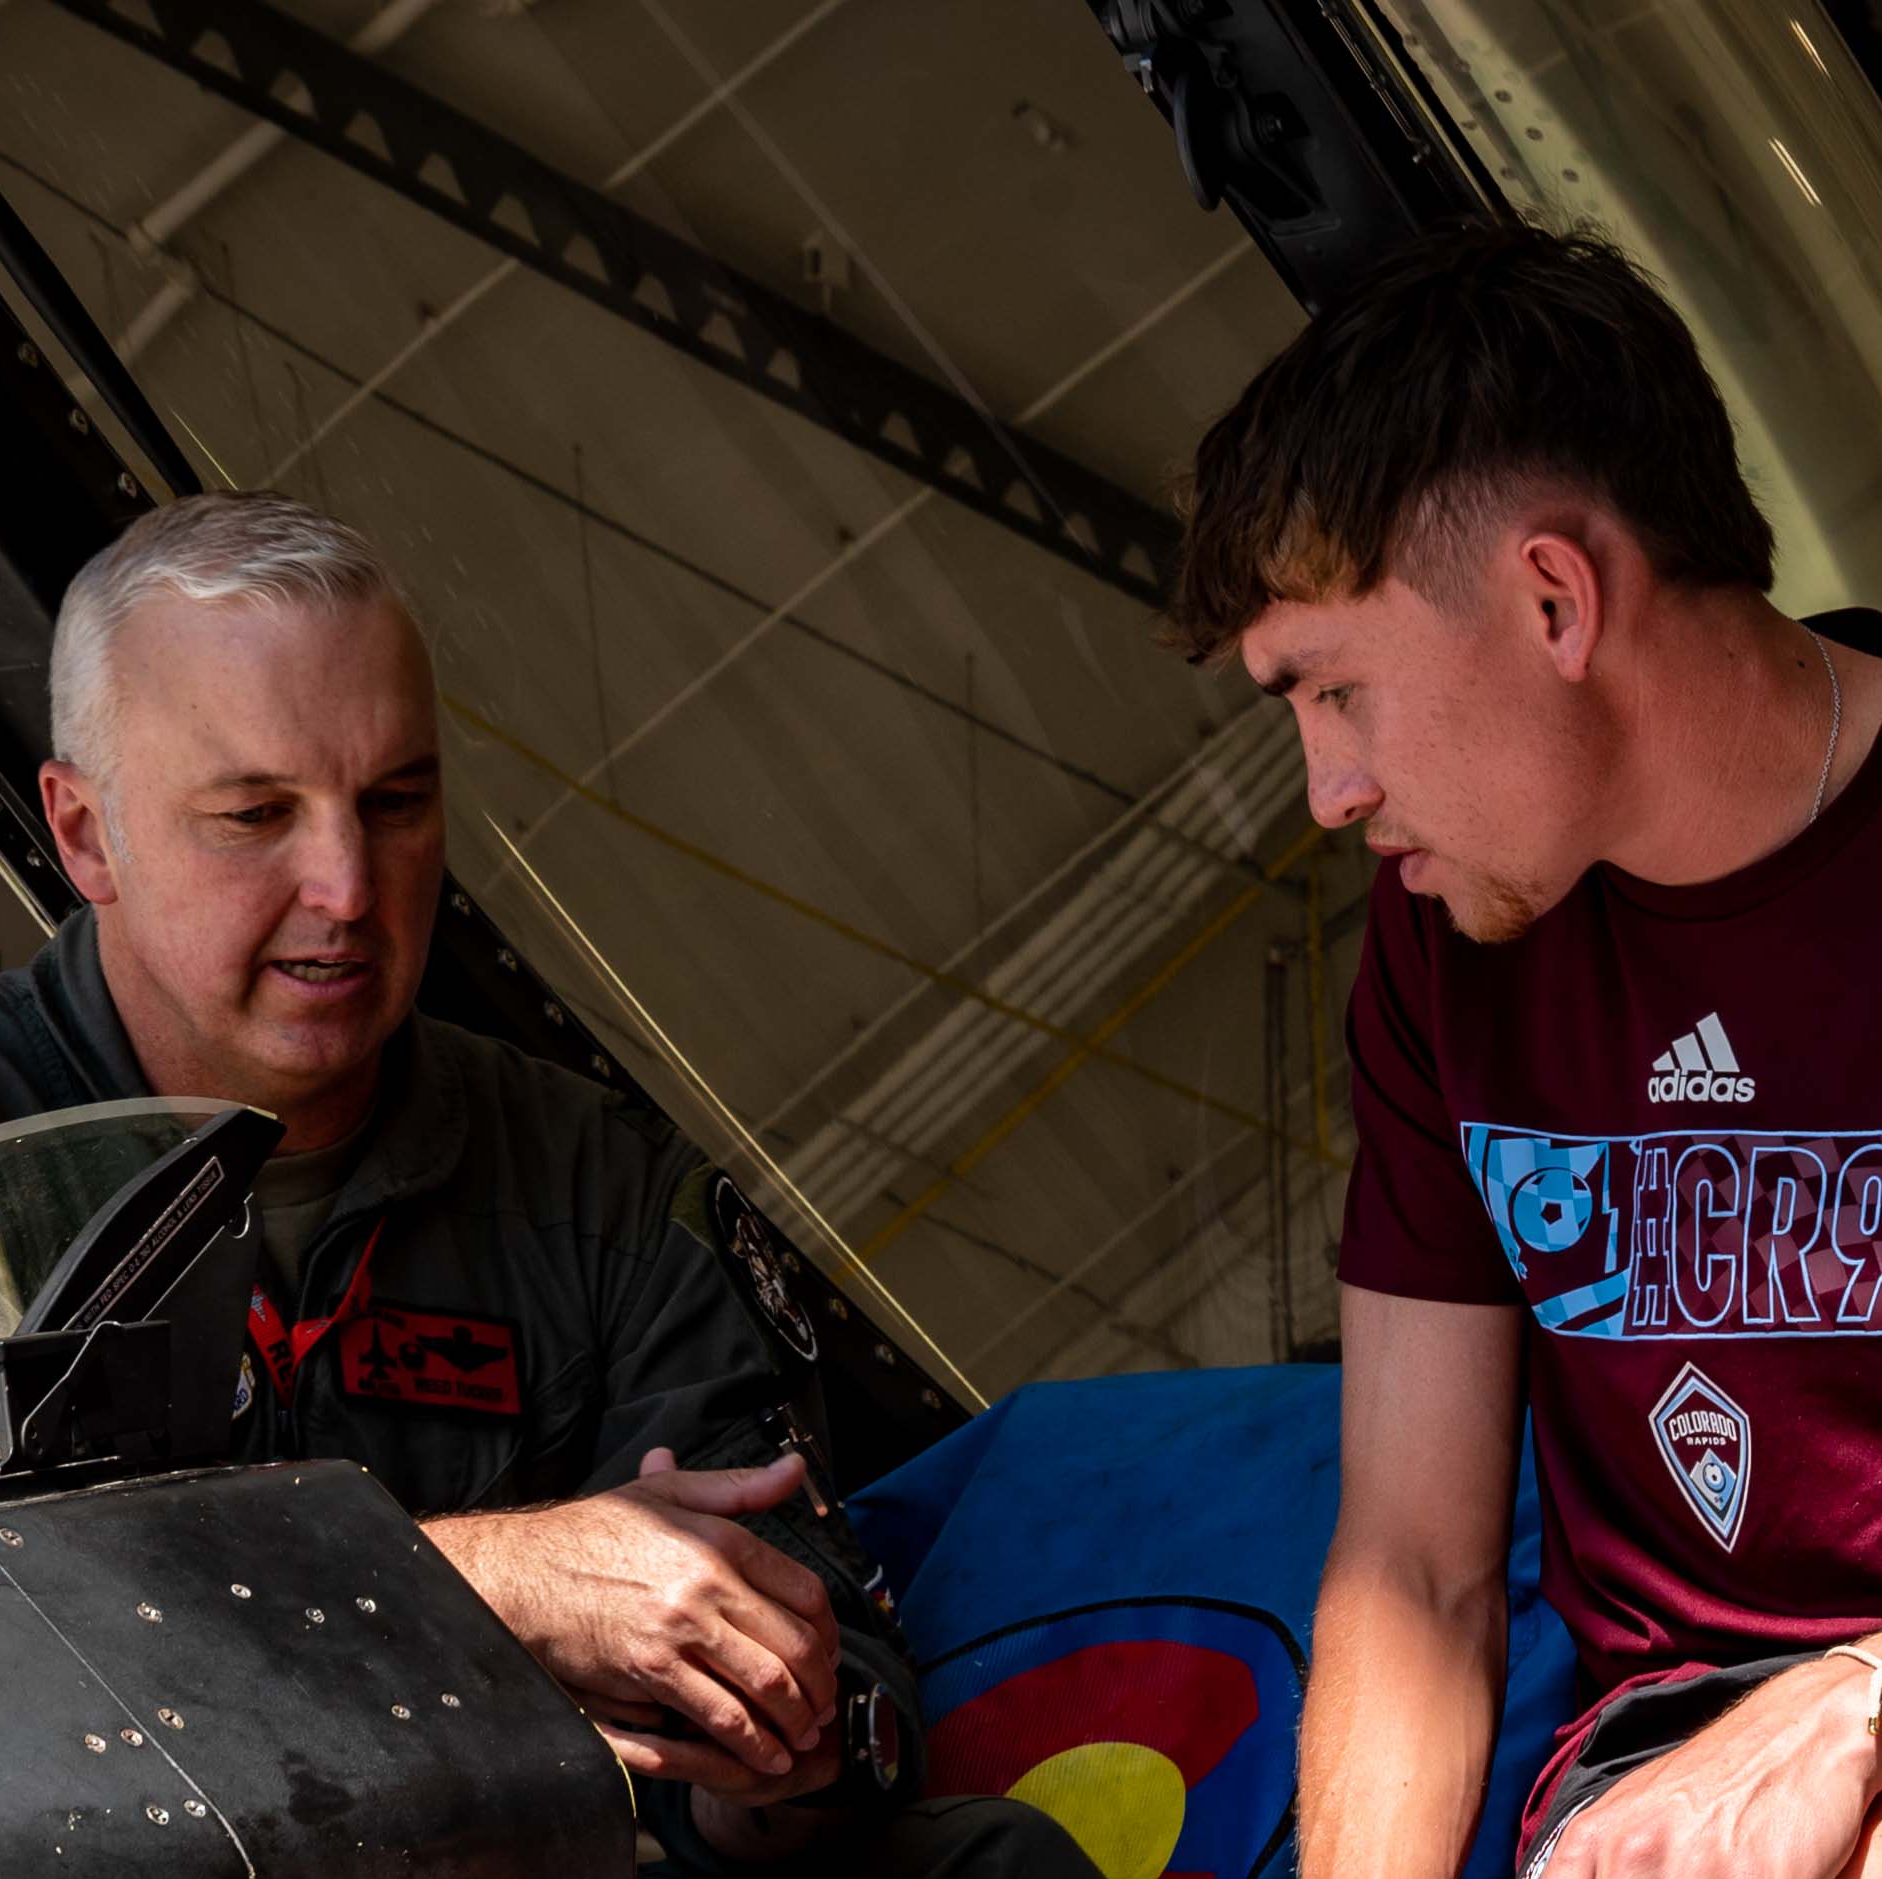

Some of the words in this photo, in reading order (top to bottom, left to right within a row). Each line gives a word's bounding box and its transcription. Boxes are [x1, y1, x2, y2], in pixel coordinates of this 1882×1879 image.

[1646, 1068, 1756, 1104] adidas
[1668, 1410, 1738, 1443] COLORADO
[1685, 1436, 1728, 1447] RAPIDS
